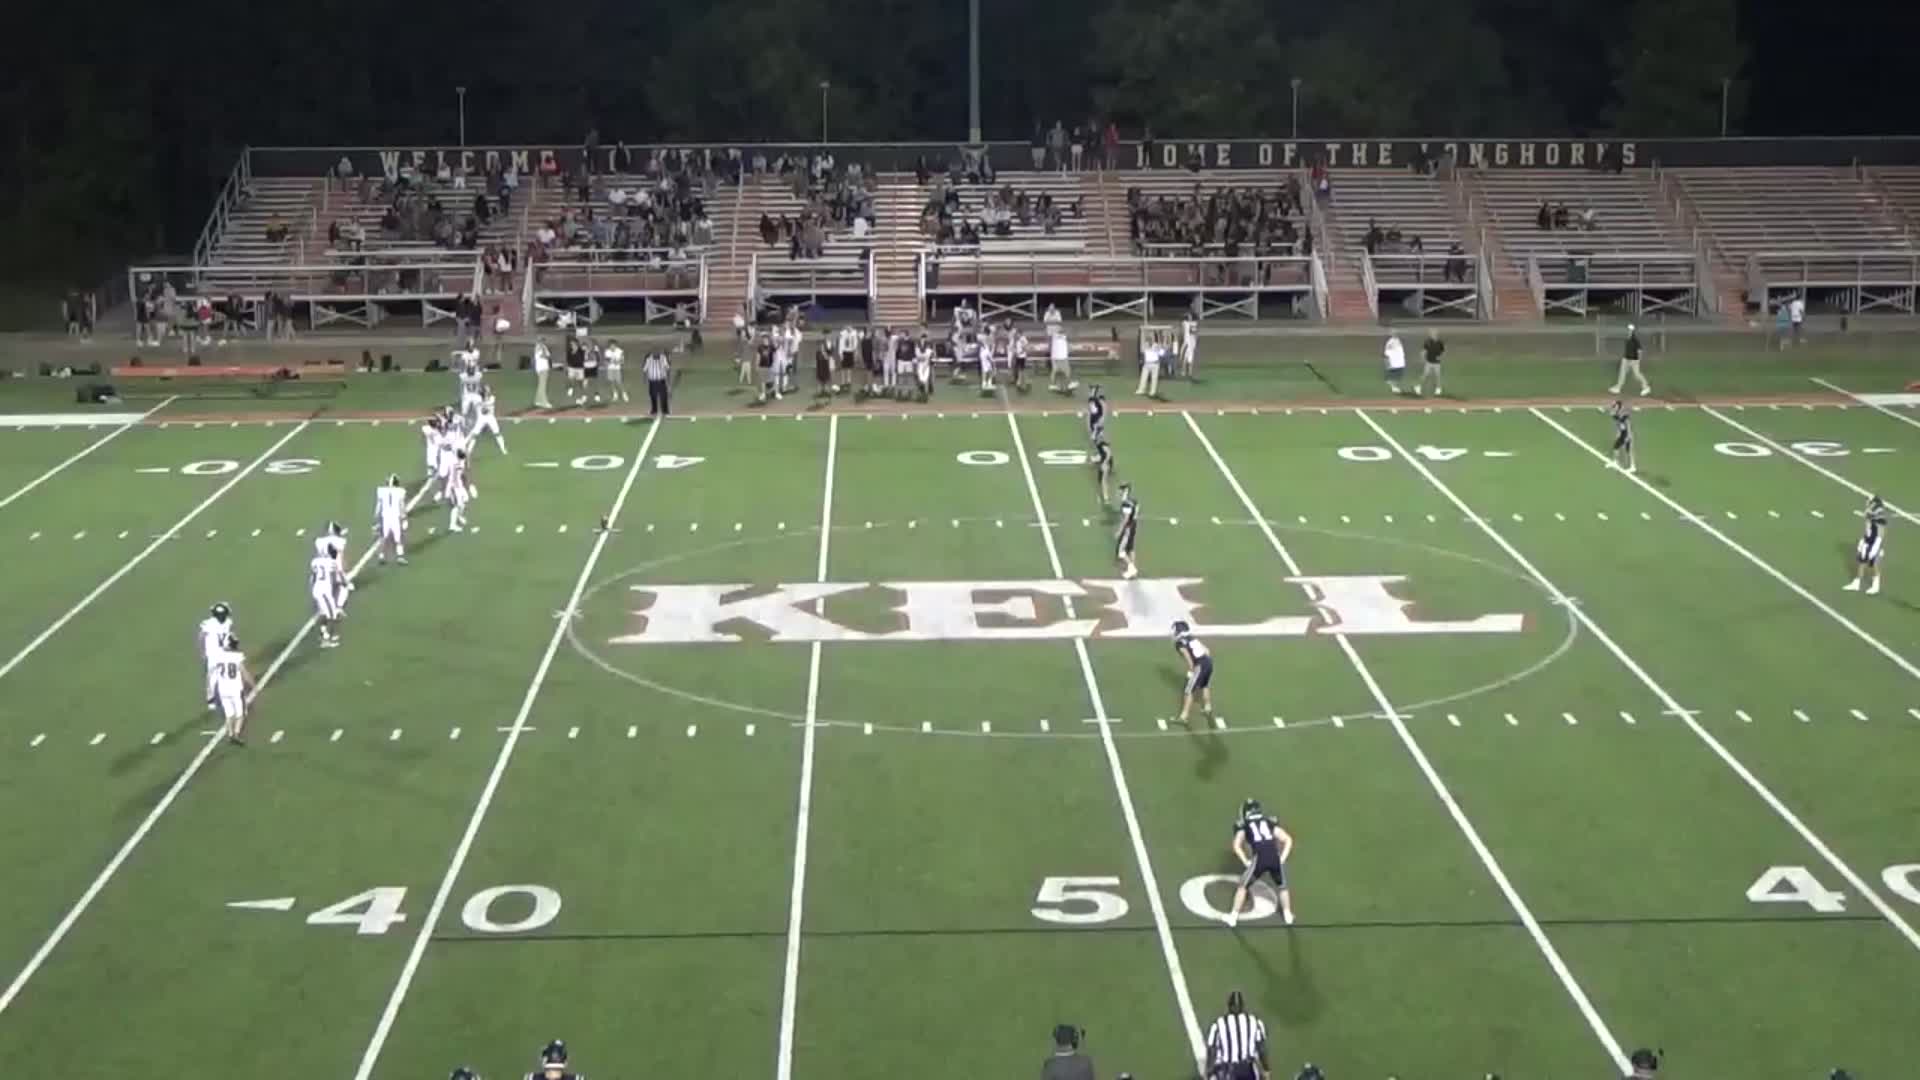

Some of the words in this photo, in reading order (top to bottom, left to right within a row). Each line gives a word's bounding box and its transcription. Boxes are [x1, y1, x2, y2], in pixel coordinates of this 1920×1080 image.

[1259, 143, 1296, 166] OF
[1326, 143, 1392, 165] THE
[1420, 143, 1635, 166] ONGHORS
[609, 576, 1524, 644] KELL
[1249, 820, 1273, 841] 14
